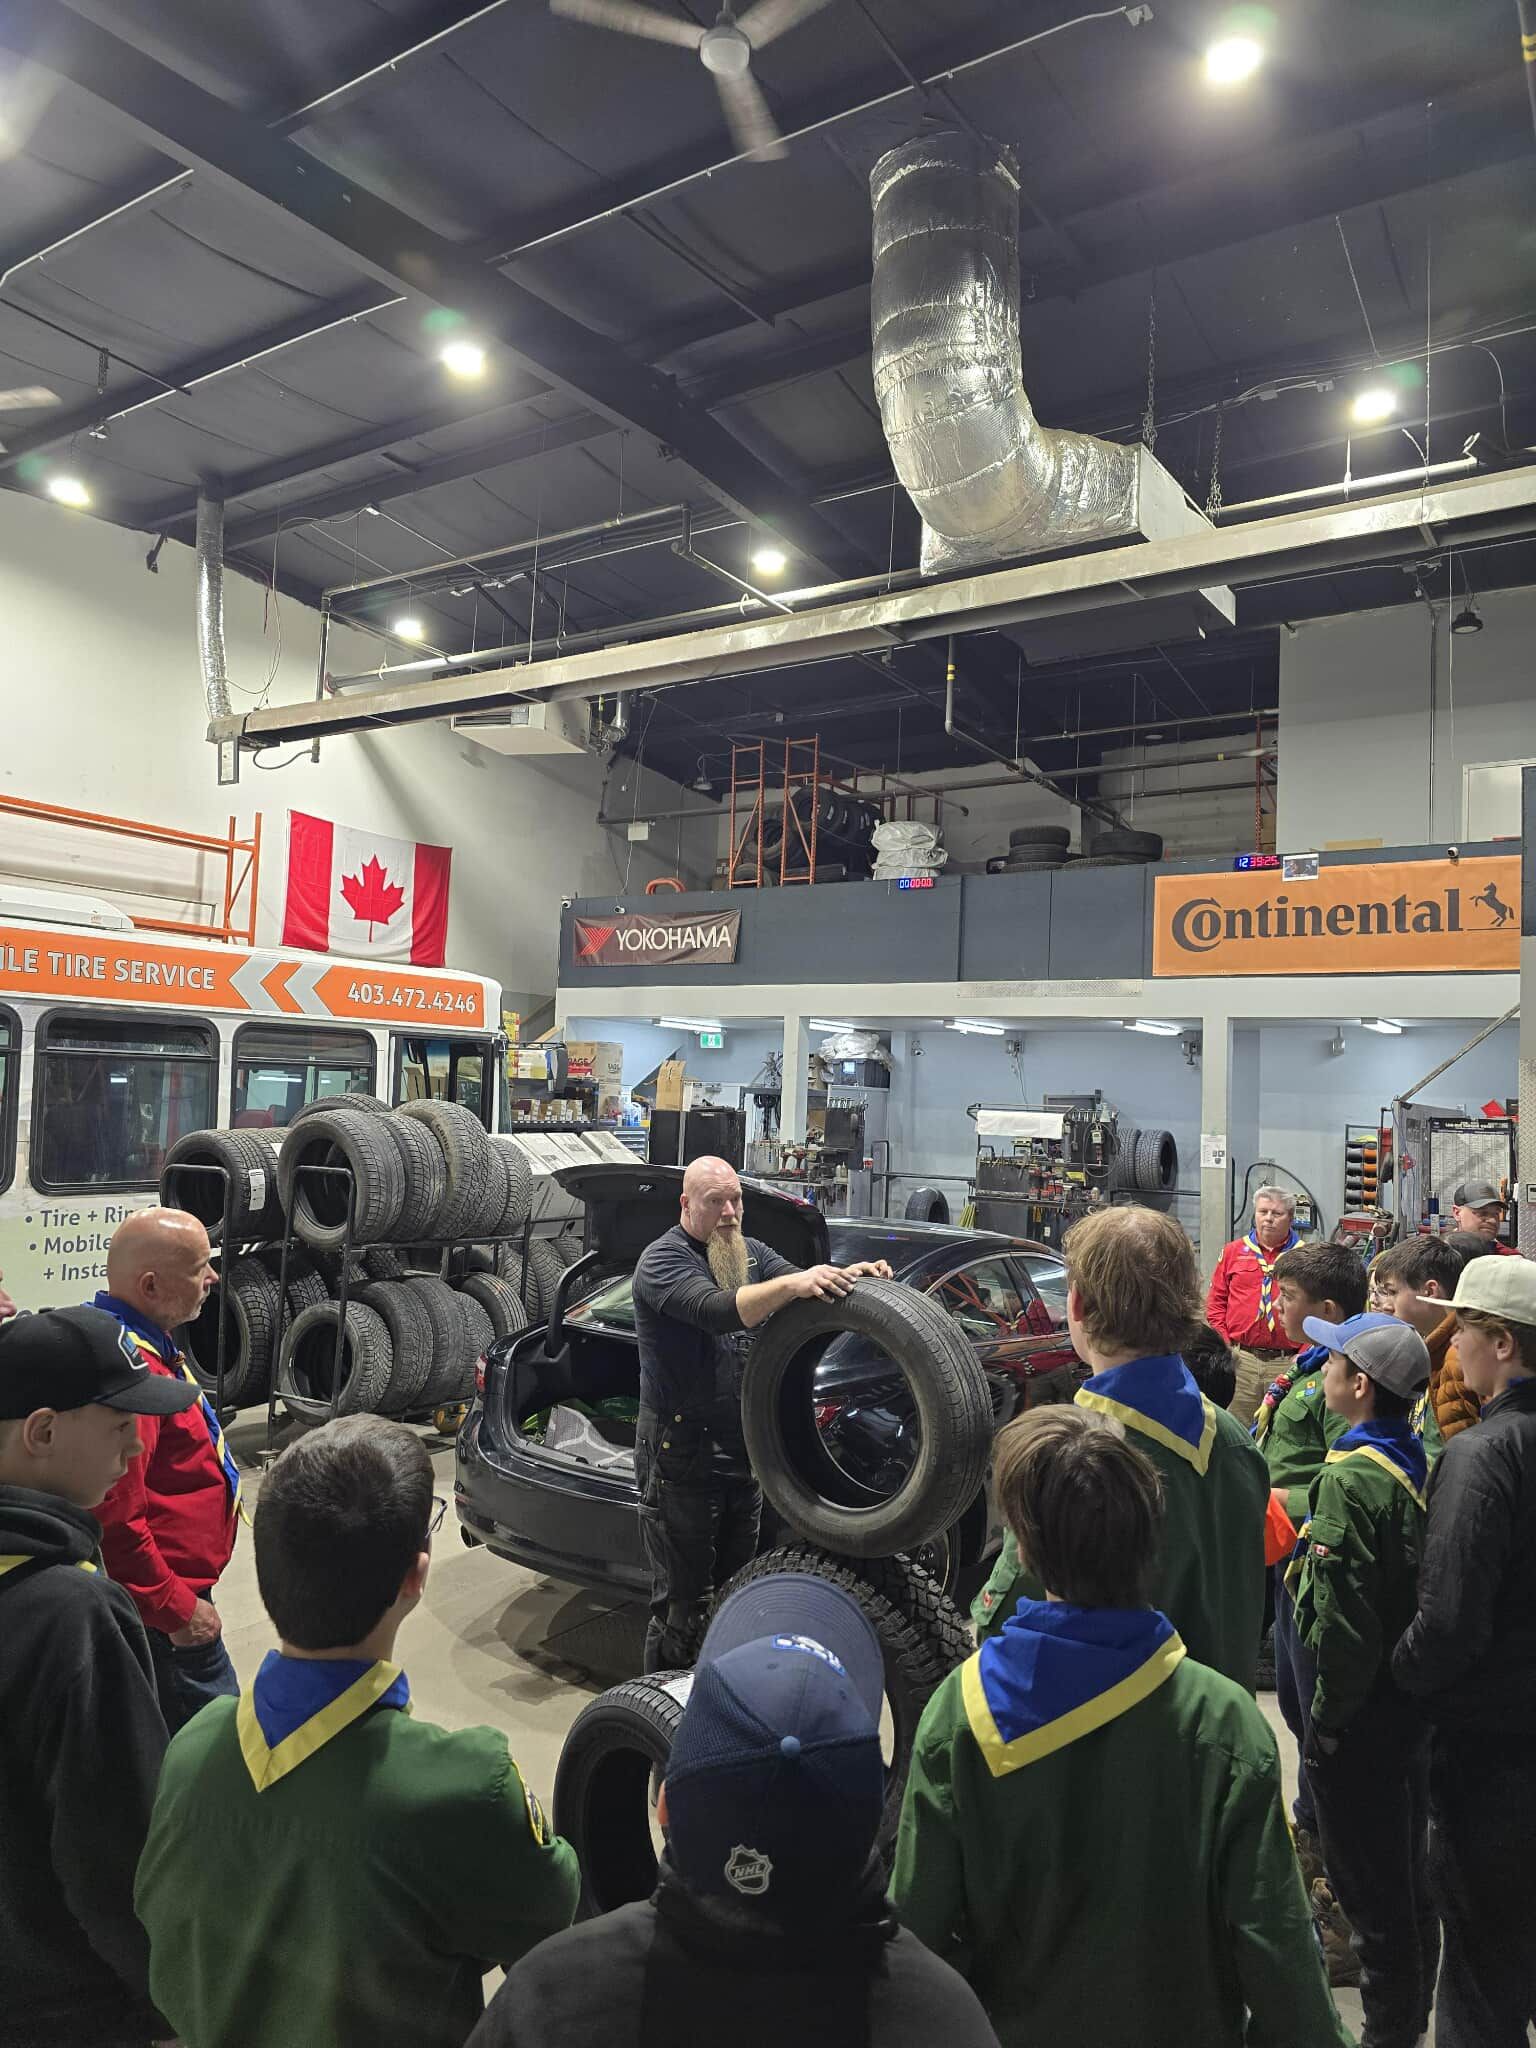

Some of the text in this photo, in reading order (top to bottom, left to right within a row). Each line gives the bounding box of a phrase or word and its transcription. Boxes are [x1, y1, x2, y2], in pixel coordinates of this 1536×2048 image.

[1171, 888, 1464, 953] Continental
[615, 925, 732, 951] YOKOHAMA
[47, 950, 107, 980] TIRE
[113, 958, 217, 990] SERVICE
[347, 982, 476, 1013] 403.472.4246
[40, 1209, 81, 1228] Tire
[44, 1234, 112, 1255] Mobile
[734, 1863, 762, 1878] NHL
